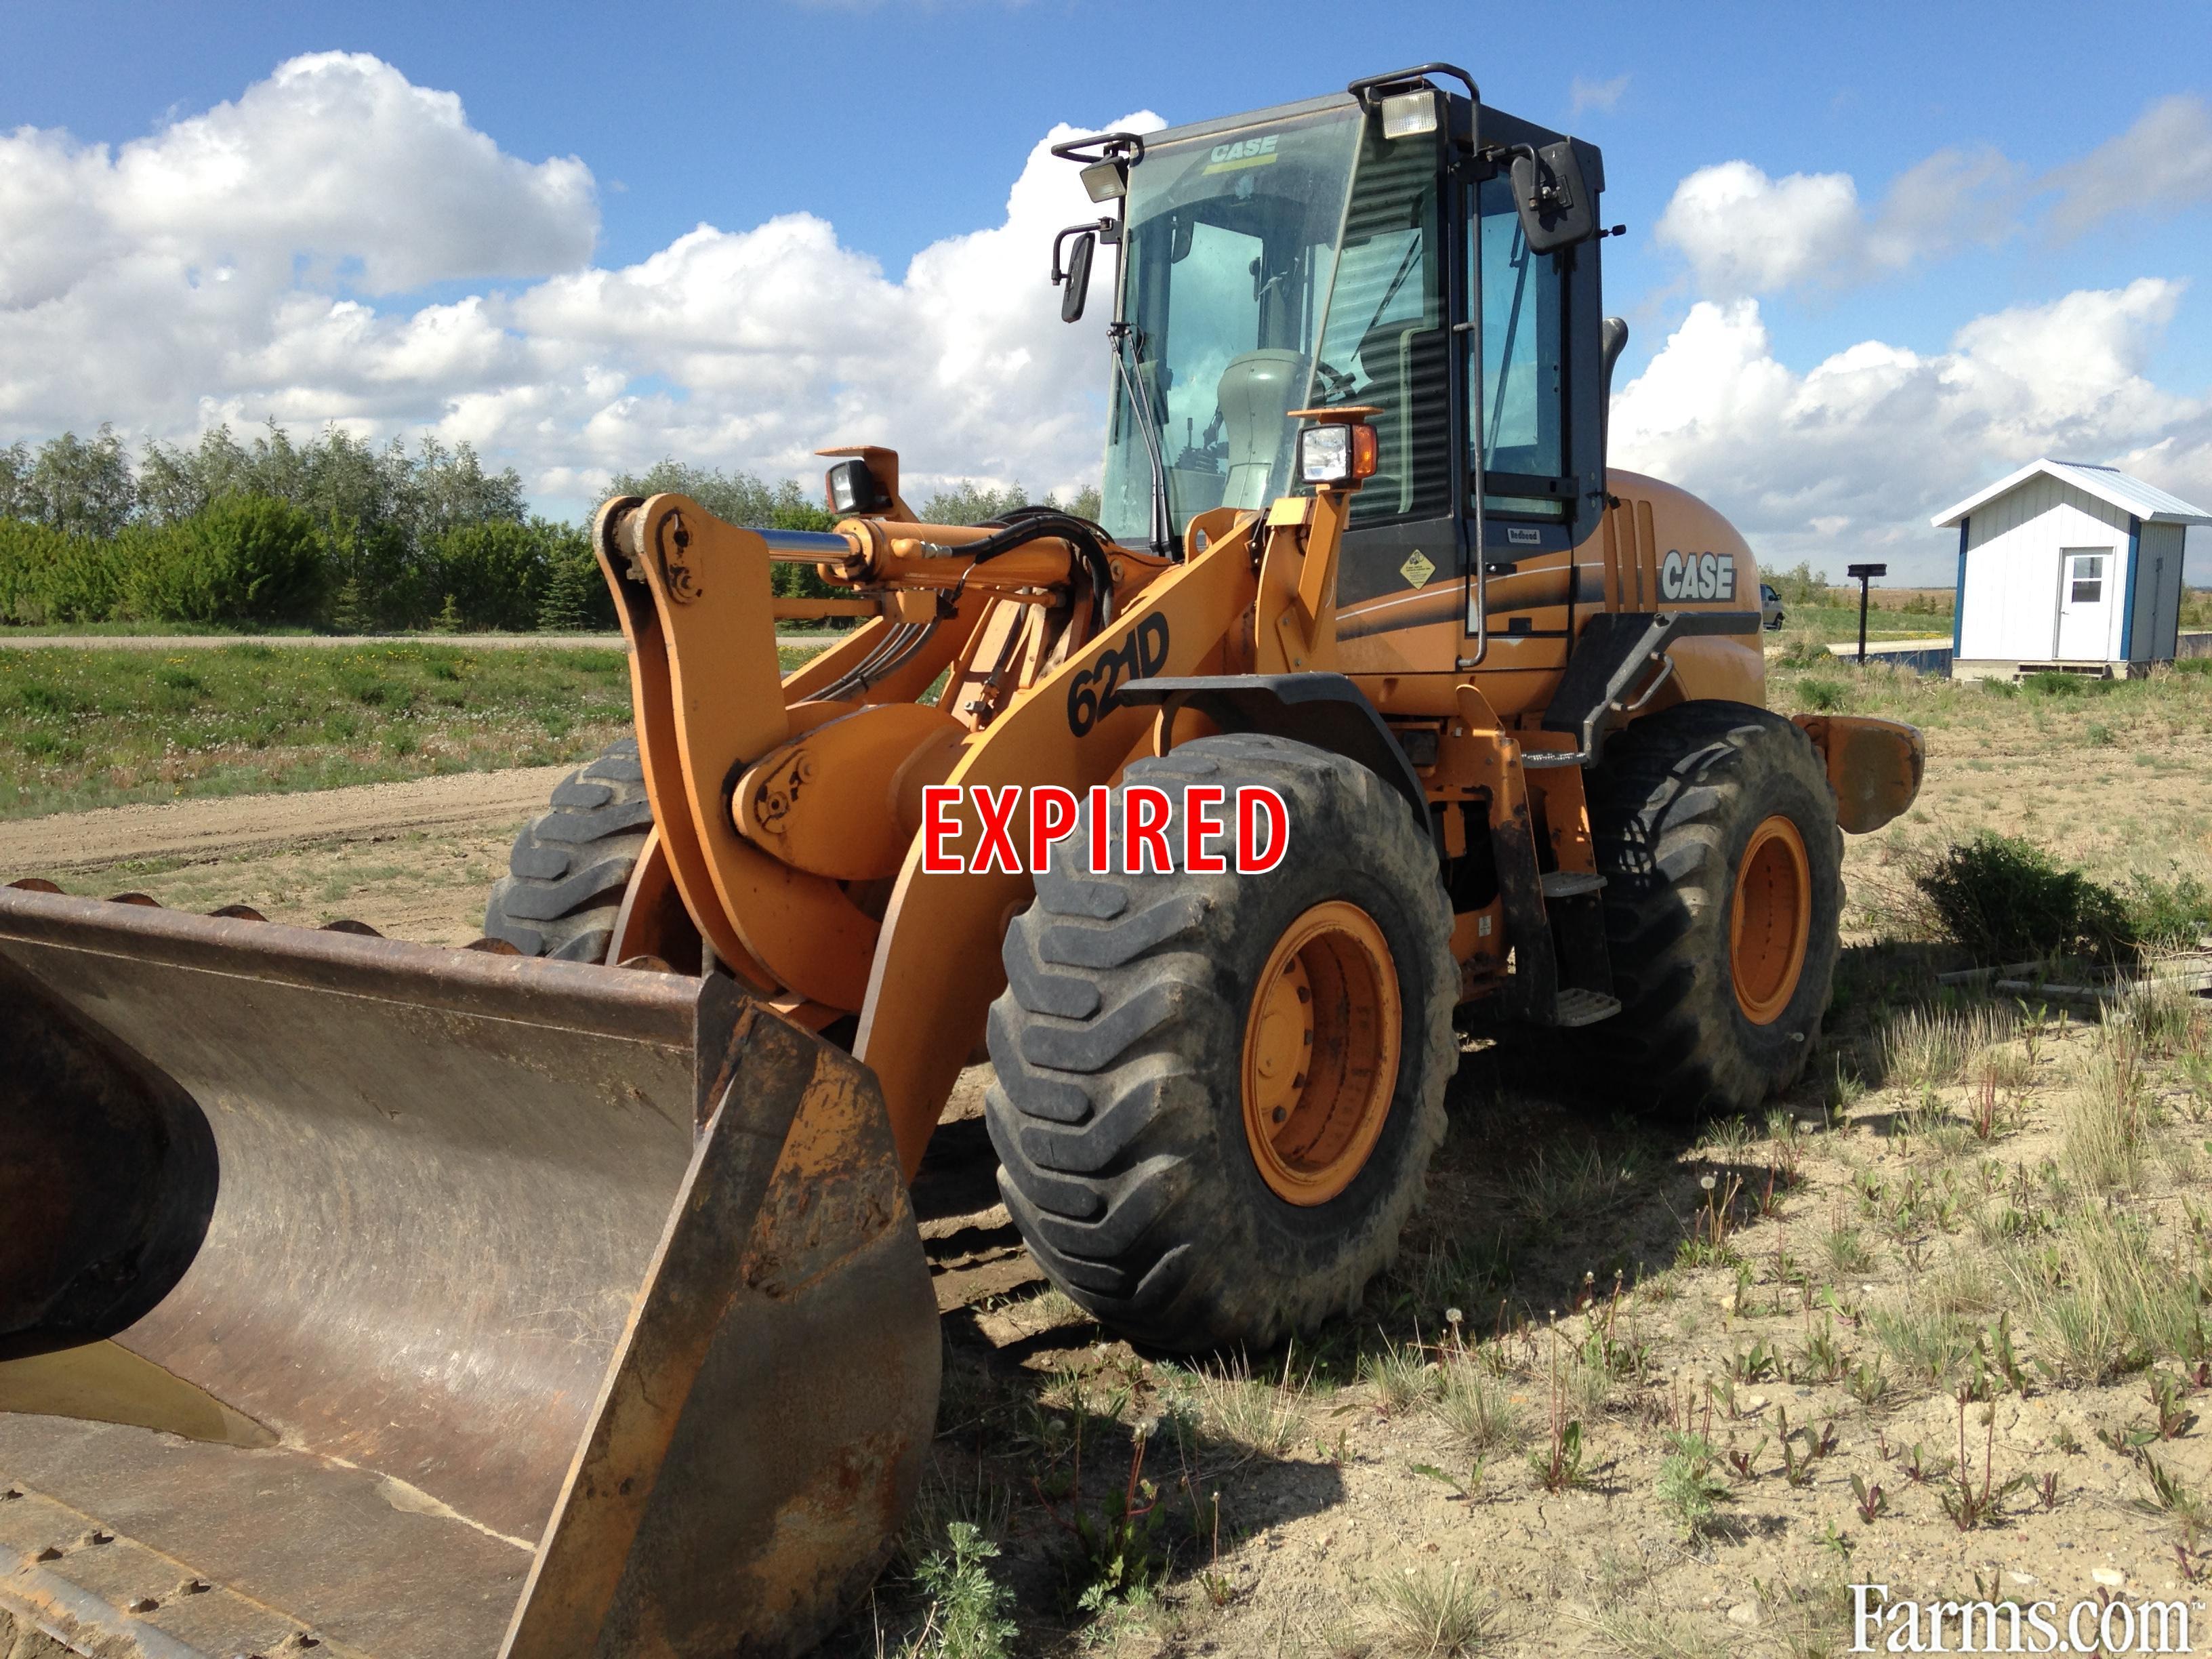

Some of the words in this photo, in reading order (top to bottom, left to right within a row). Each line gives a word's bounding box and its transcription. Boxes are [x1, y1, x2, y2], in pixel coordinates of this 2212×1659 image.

[1211, 134, 1279, 163] CASE
[1662, 550, 1734, 600] CASE
[1067, 611, 1170, 738] 621D
